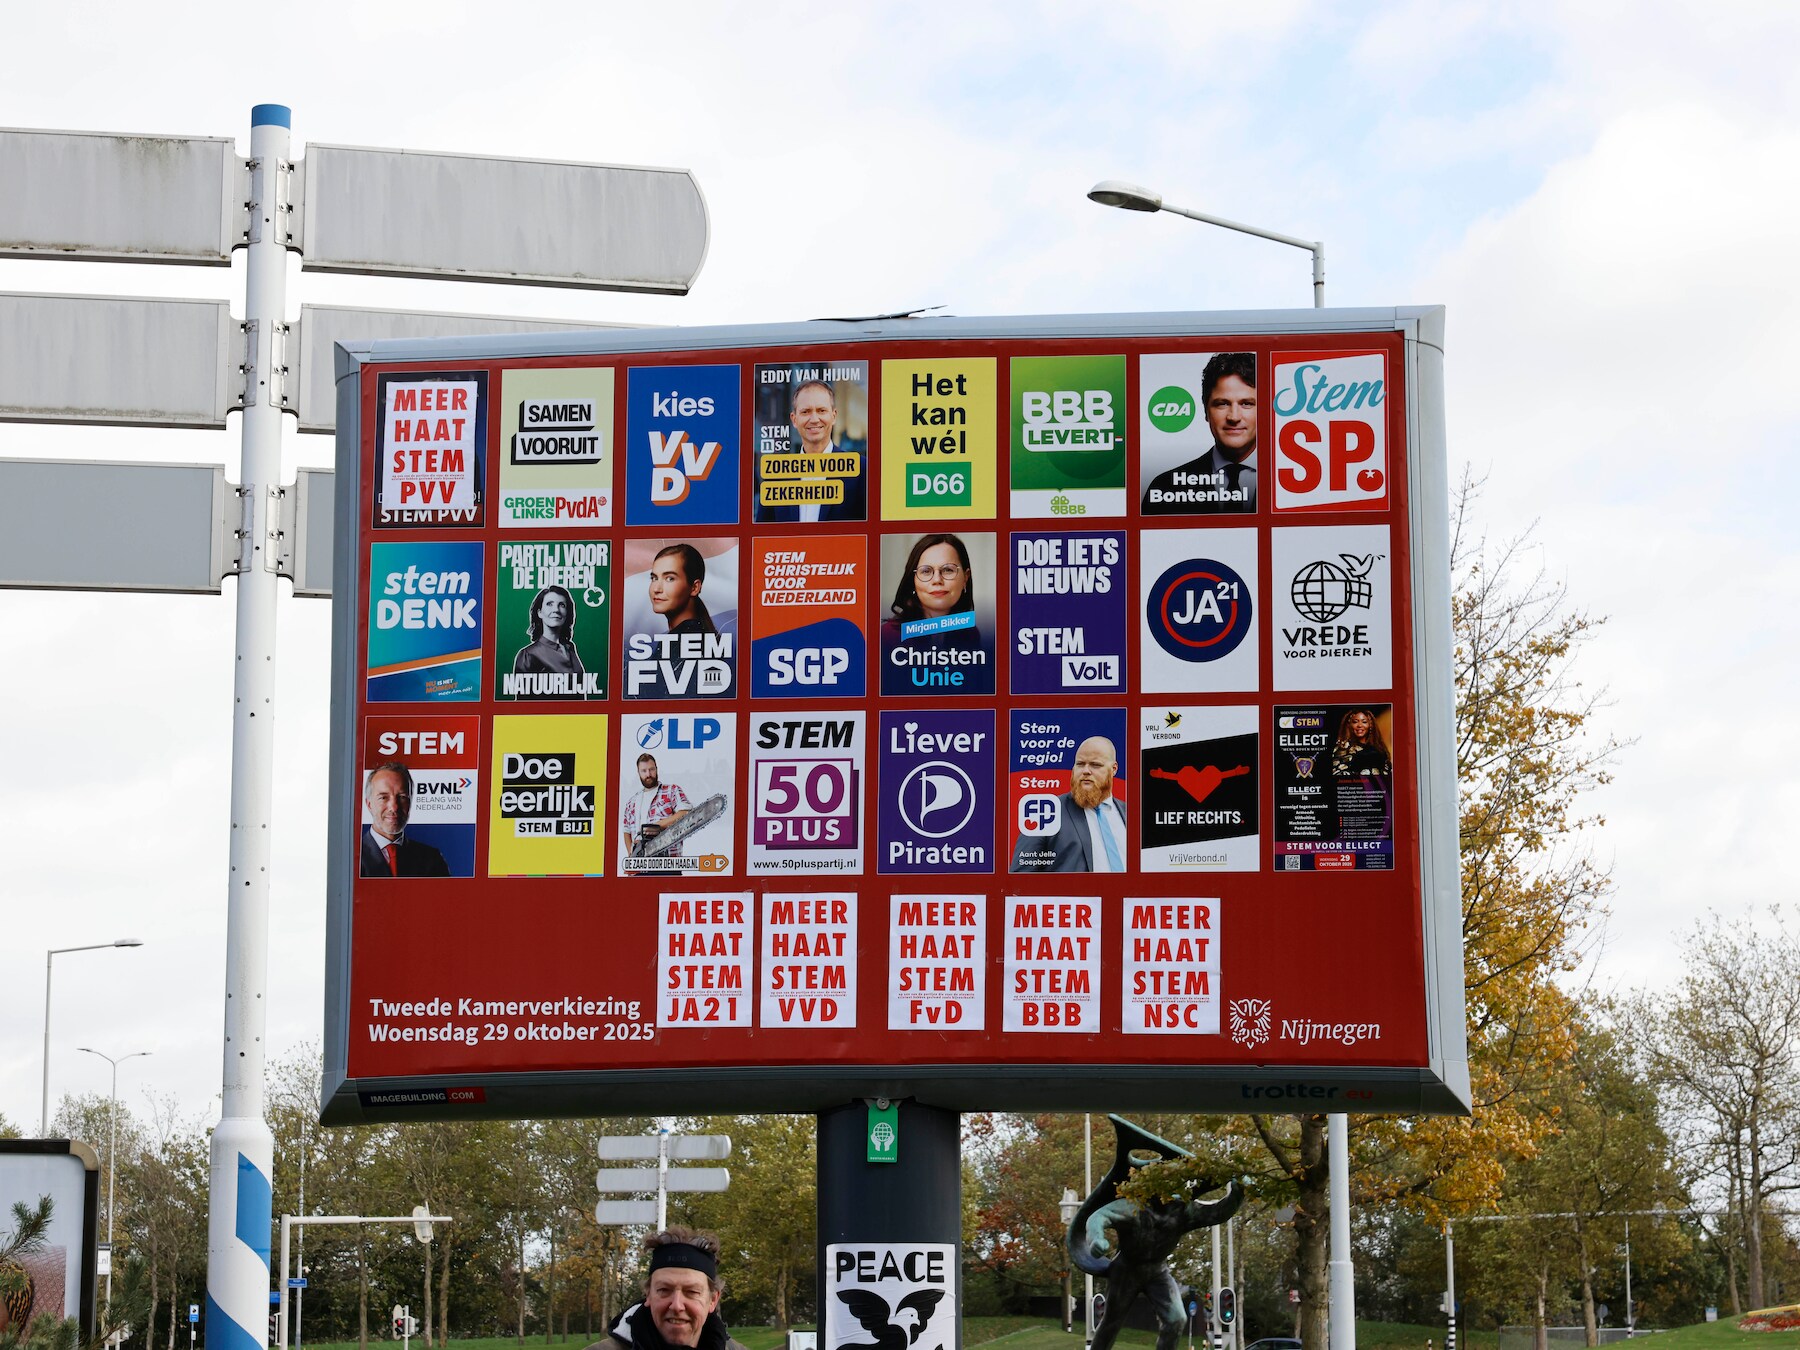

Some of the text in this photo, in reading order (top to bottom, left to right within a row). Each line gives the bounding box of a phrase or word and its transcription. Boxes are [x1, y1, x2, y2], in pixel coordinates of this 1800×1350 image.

[761, 368, 860, 383] EDDY VAN HIJUM
[912, 373, 967, 396] Het
[394, 389, 467, 411] MEER
[1273, 365, 1386, 416] Stem
[529, 404, 592, 422] SAMEN
[653, 391, 714, 417] kies
[912, 403, 965, 425] kan
[1023, 390, 1114, 423] BBB
[1152, 402, 1190, 417] CDA
[395, 419, 465, 442] HAAT
[761, 426, 790, 438] STEM
[911, 430, 965, 454] wél
[1028, 429, 1113, 445] LEVERT
[520, 437, 598, 455] VOORUIT
[393, 450, 464, 472] STEM
[765, 458, 854, 473] ZORGEN VOOR
[912, 473, 965, 495] D66
[1173, 470, 1225, 485] Henri
[401, 481, 456, 503] PVV
[504, 497, 555, 508] GROEN
[765, 486, 839, 500] ZEKERHEID!
[1150, 487, 1248, 503] Bontenbal
[381, 507, 477, 522] STEM PVV
[512, 508, 554, 519] LINKS
[555, 496, 598, 519] PvdA
[1060, 505, 1086, 514] BBB
[501, 544, 608, 567] PARTIJ VOOR
[764, 552, 806, 563] STEM
[1018, 538, 1119, 566] DOE IETS
[384, 565, 470, 595] stem
[513, 566, 595, 589] DE DIEREN
[764, 564, 856, 577] CHRISTELIJK
[1018, 567, 1111, 594] NIEUWS
[764, 577, 806, 589] VOOR
[763, 591, 854, 604] NEDERLAND
[377, 599, 477, 629] DENK
[906, 616, 970, 635] Mirjam Bikker
[629, 633, 732, 660] STEM
[1018, 627, 1085, 655] STEM
[1282, 625, 1368, 647] VREDE
[891, 646, 985, 666] Christen
[1283, 648, 1371, 659] VOOR DIEREN
[628, 659, 731, 696] FVD
[768, 647, 849, 685] SGP
[912, 667, 964, 686] Unie
[1069, 661, 1112, 680] Volt
[503, 673, 602, 695] NATUURLIJK.
[667, 718, 721, 749] LP
[1020, 723, 1060, 734] Stem
[1297, 718, 1319, 726] STEM
[378, 732, 464, 755] STEM
[756, 721, 855, 749] STEM
[891, 722, 985, 754] Liever
[1020, 737, 1075, 748] voor de
[1280, 734, 1328, 746] ELLECT
[503, 753, 562, 780] Doe
[1020, 752, 1063, 765] regio!
[417, 783, 462, 795] BVNL
[765, 764, 845, 814] 50
[1020, 777, 1060, 788] Stem
[500, 786, 595, 819] eerlijk.
[519, 822, 589, 833] STEM BIJ1
[1156, 812, 1184, 824] LIEF
[767, 819, 841, 842] PLUS
[625, 859, 632, 869] DE
[633, 859, 647, 869] ZAAG
[664, 859, 675, 868] DEN
[889, 841, 984, 864] Piraten
[1169, 854, 1227, 864] VrijVerbond.nl
[754, 859, 856, 870] www.50pluspartij.nl
[667, 901, 744, 924] MEER
[770, 901, 848, 924] MEER
[898, 903, 976, 926] MEER
[1014, 904, 1092, 928] MEER
[1132, 905, 1211, 929] MEER
[669, 932, 742, 956] HAAT
[773, 933, 846, 956] HAAT
[900, 935, 974, 958] HAAT
[1015, 937, 1090, 960] HAAT
[1134, 938, 1209, 962] HAAT
[668, 965, 742, 989] STEM
[772, 966, 846, 989] STEM
[899, 967, 974, 991] STEM
[1015, 969, 1090, 993] STEM
[1134, 971, 1209, 995] STEM
[370, 996, 640, 1020] Tweede Kamerverkiezing
[668, 998, 736, 1021] JA21
[779, 998, 838, 1022] VVD
[910, 1000, 963, 1024] FvD
[1023, 1002, 1081, 1026] BBB
[1144, 1004, 1198, 1028] NSC
[369, 1022, 655, 1046] Woensdag 29 oktober 2025
[1280, 1019, 1380, 1045] Nijmegen
[836, 1250, 944, 1283] PEACE
